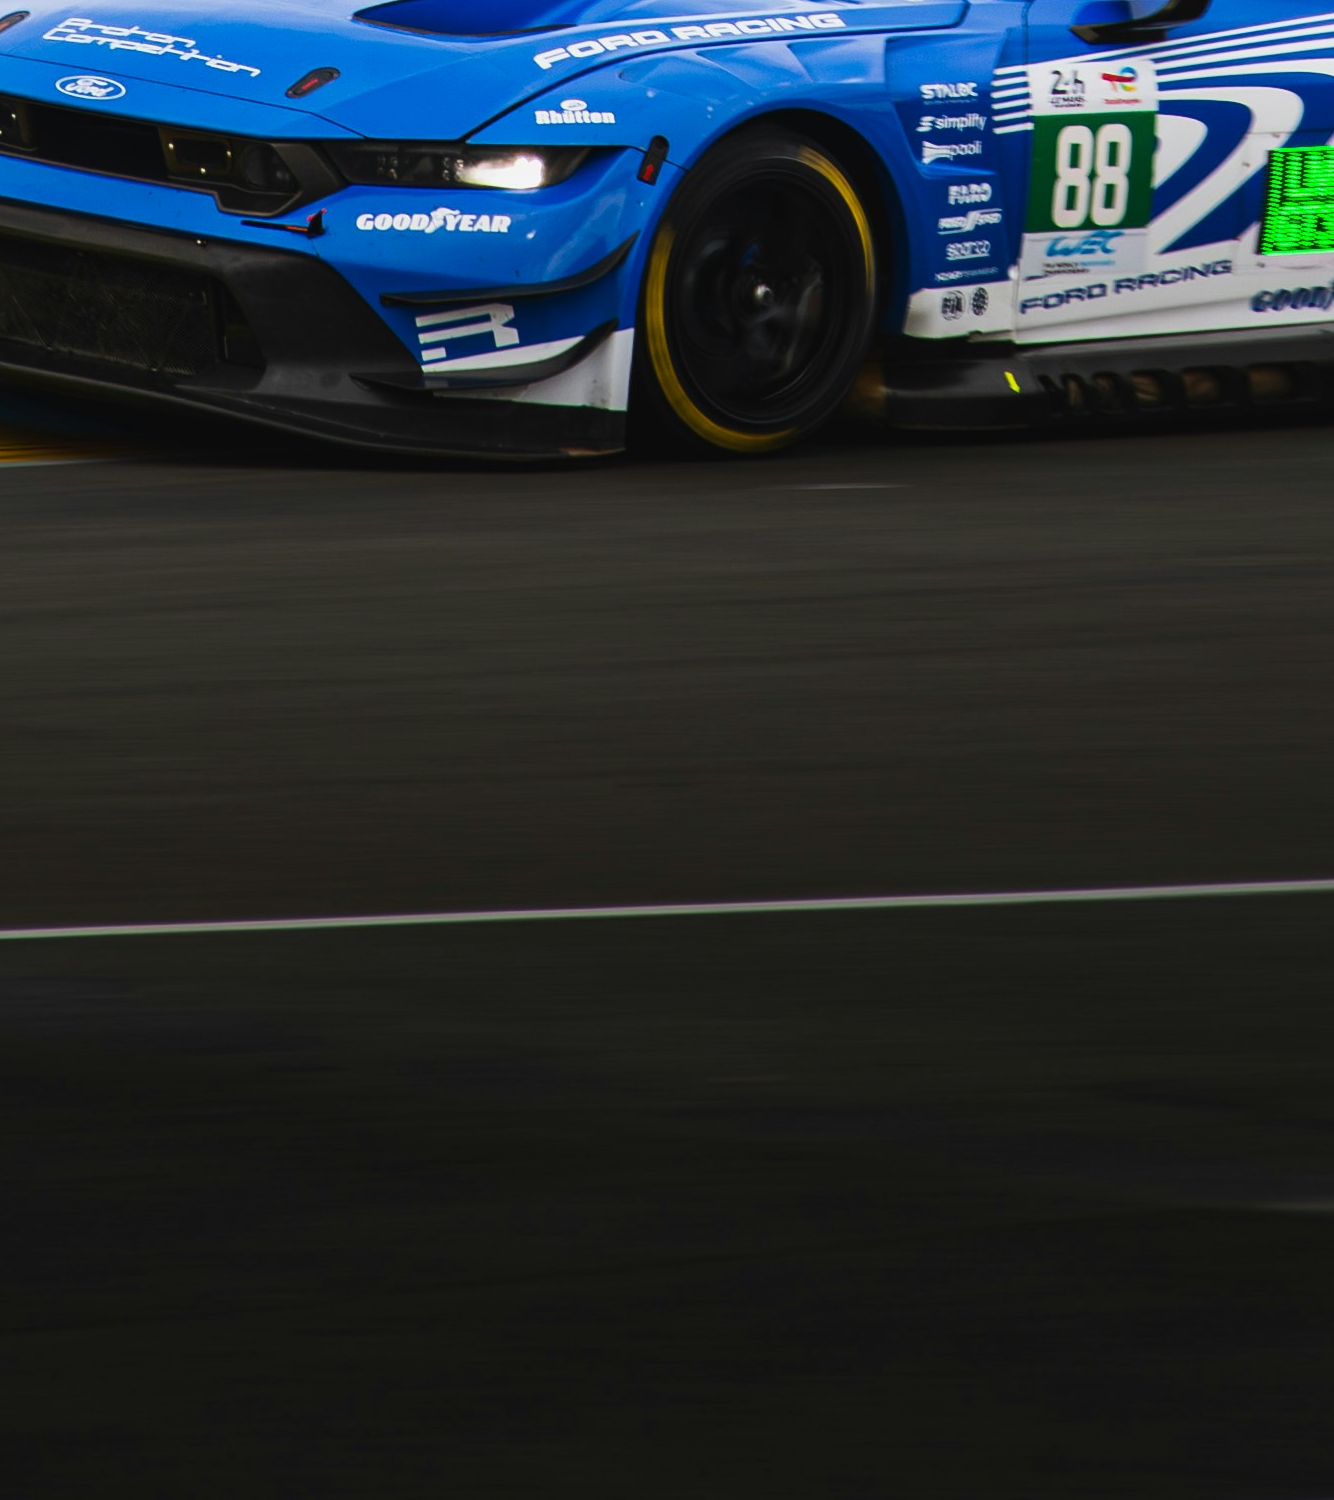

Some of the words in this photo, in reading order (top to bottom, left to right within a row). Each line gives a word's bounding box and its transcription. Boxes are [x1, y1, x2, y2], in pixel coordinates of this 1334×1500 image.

[58, 17, 197, 49] Proton
[532, 30, 672, 70] FORD
[672, 13, 847, 41] RACING
[42, 27, 262, 78] Competition
[63, 78, 116, 98] Ford
[933, 112, 987, 132] simplify
[1051, 123, 1133, 229] 88
[947, 182, 993, 205] FARO
[355, 207, 512, 234] GOODYEAR
[1019, 283, 1108, 315] FORD
[1113, 258, 1235, 295] RACING
